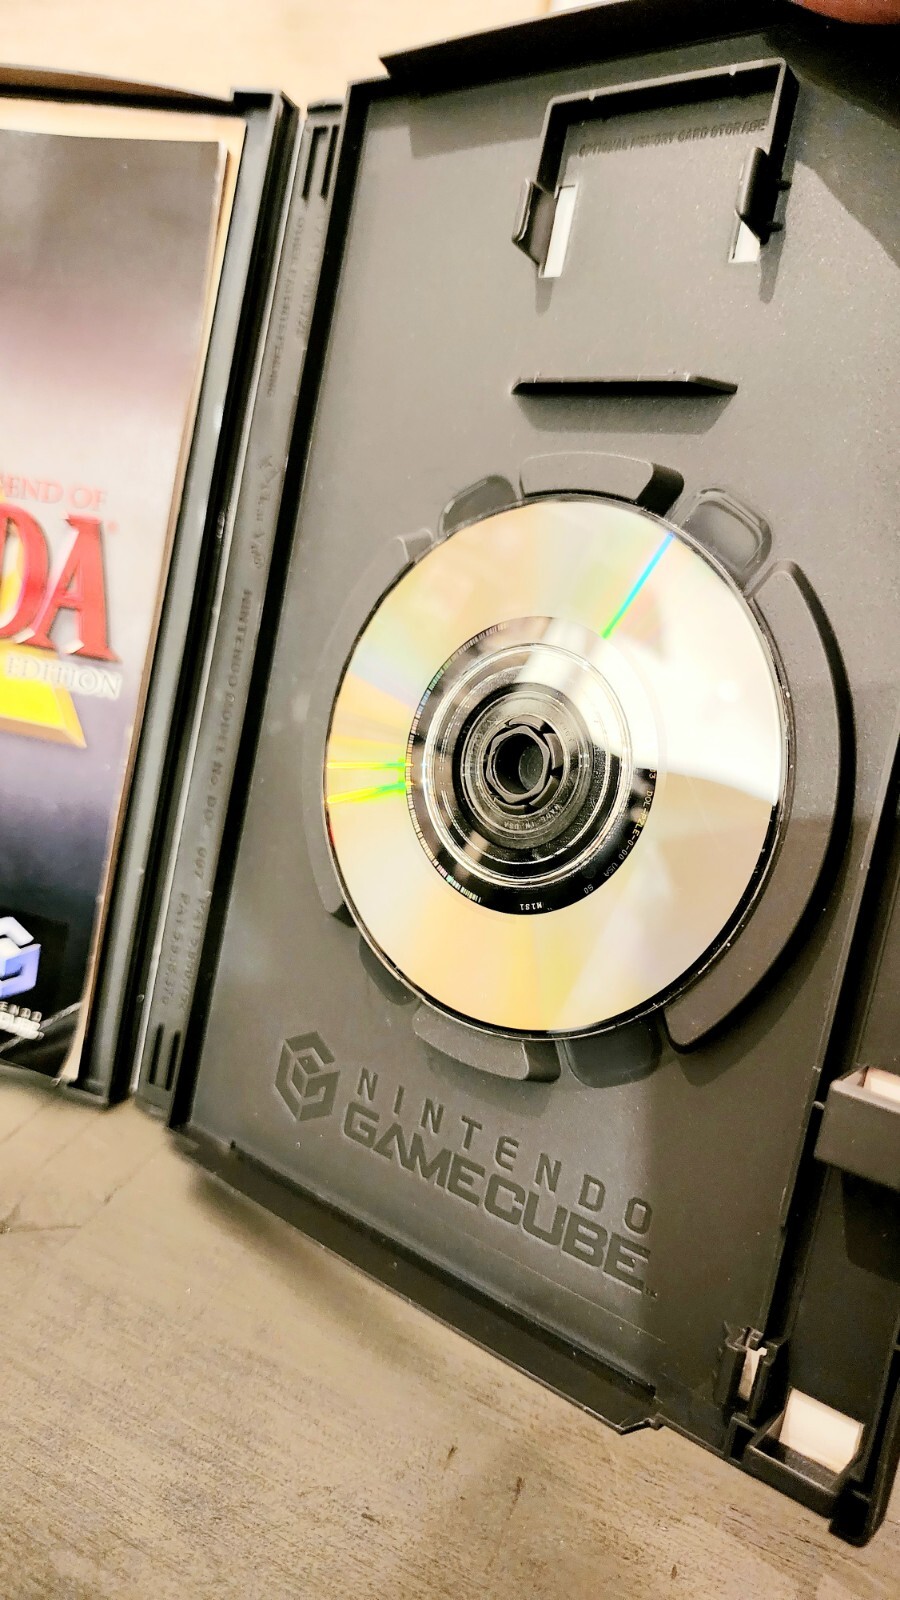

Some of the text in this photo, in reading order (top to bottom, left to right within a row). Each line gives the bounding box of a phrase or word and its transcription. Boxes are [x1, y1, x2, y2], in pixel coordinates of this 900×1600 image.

[677, 126, 709, 143] CARD
[710, 118, 768, 139] STORAGE
[0, 472, 106, 511] END OF
[603, 862, 618, 877] USA
[357, 1067, 652, 1235] NINTENDO
[343, 1102, 651, 1295] GAMECUBE
